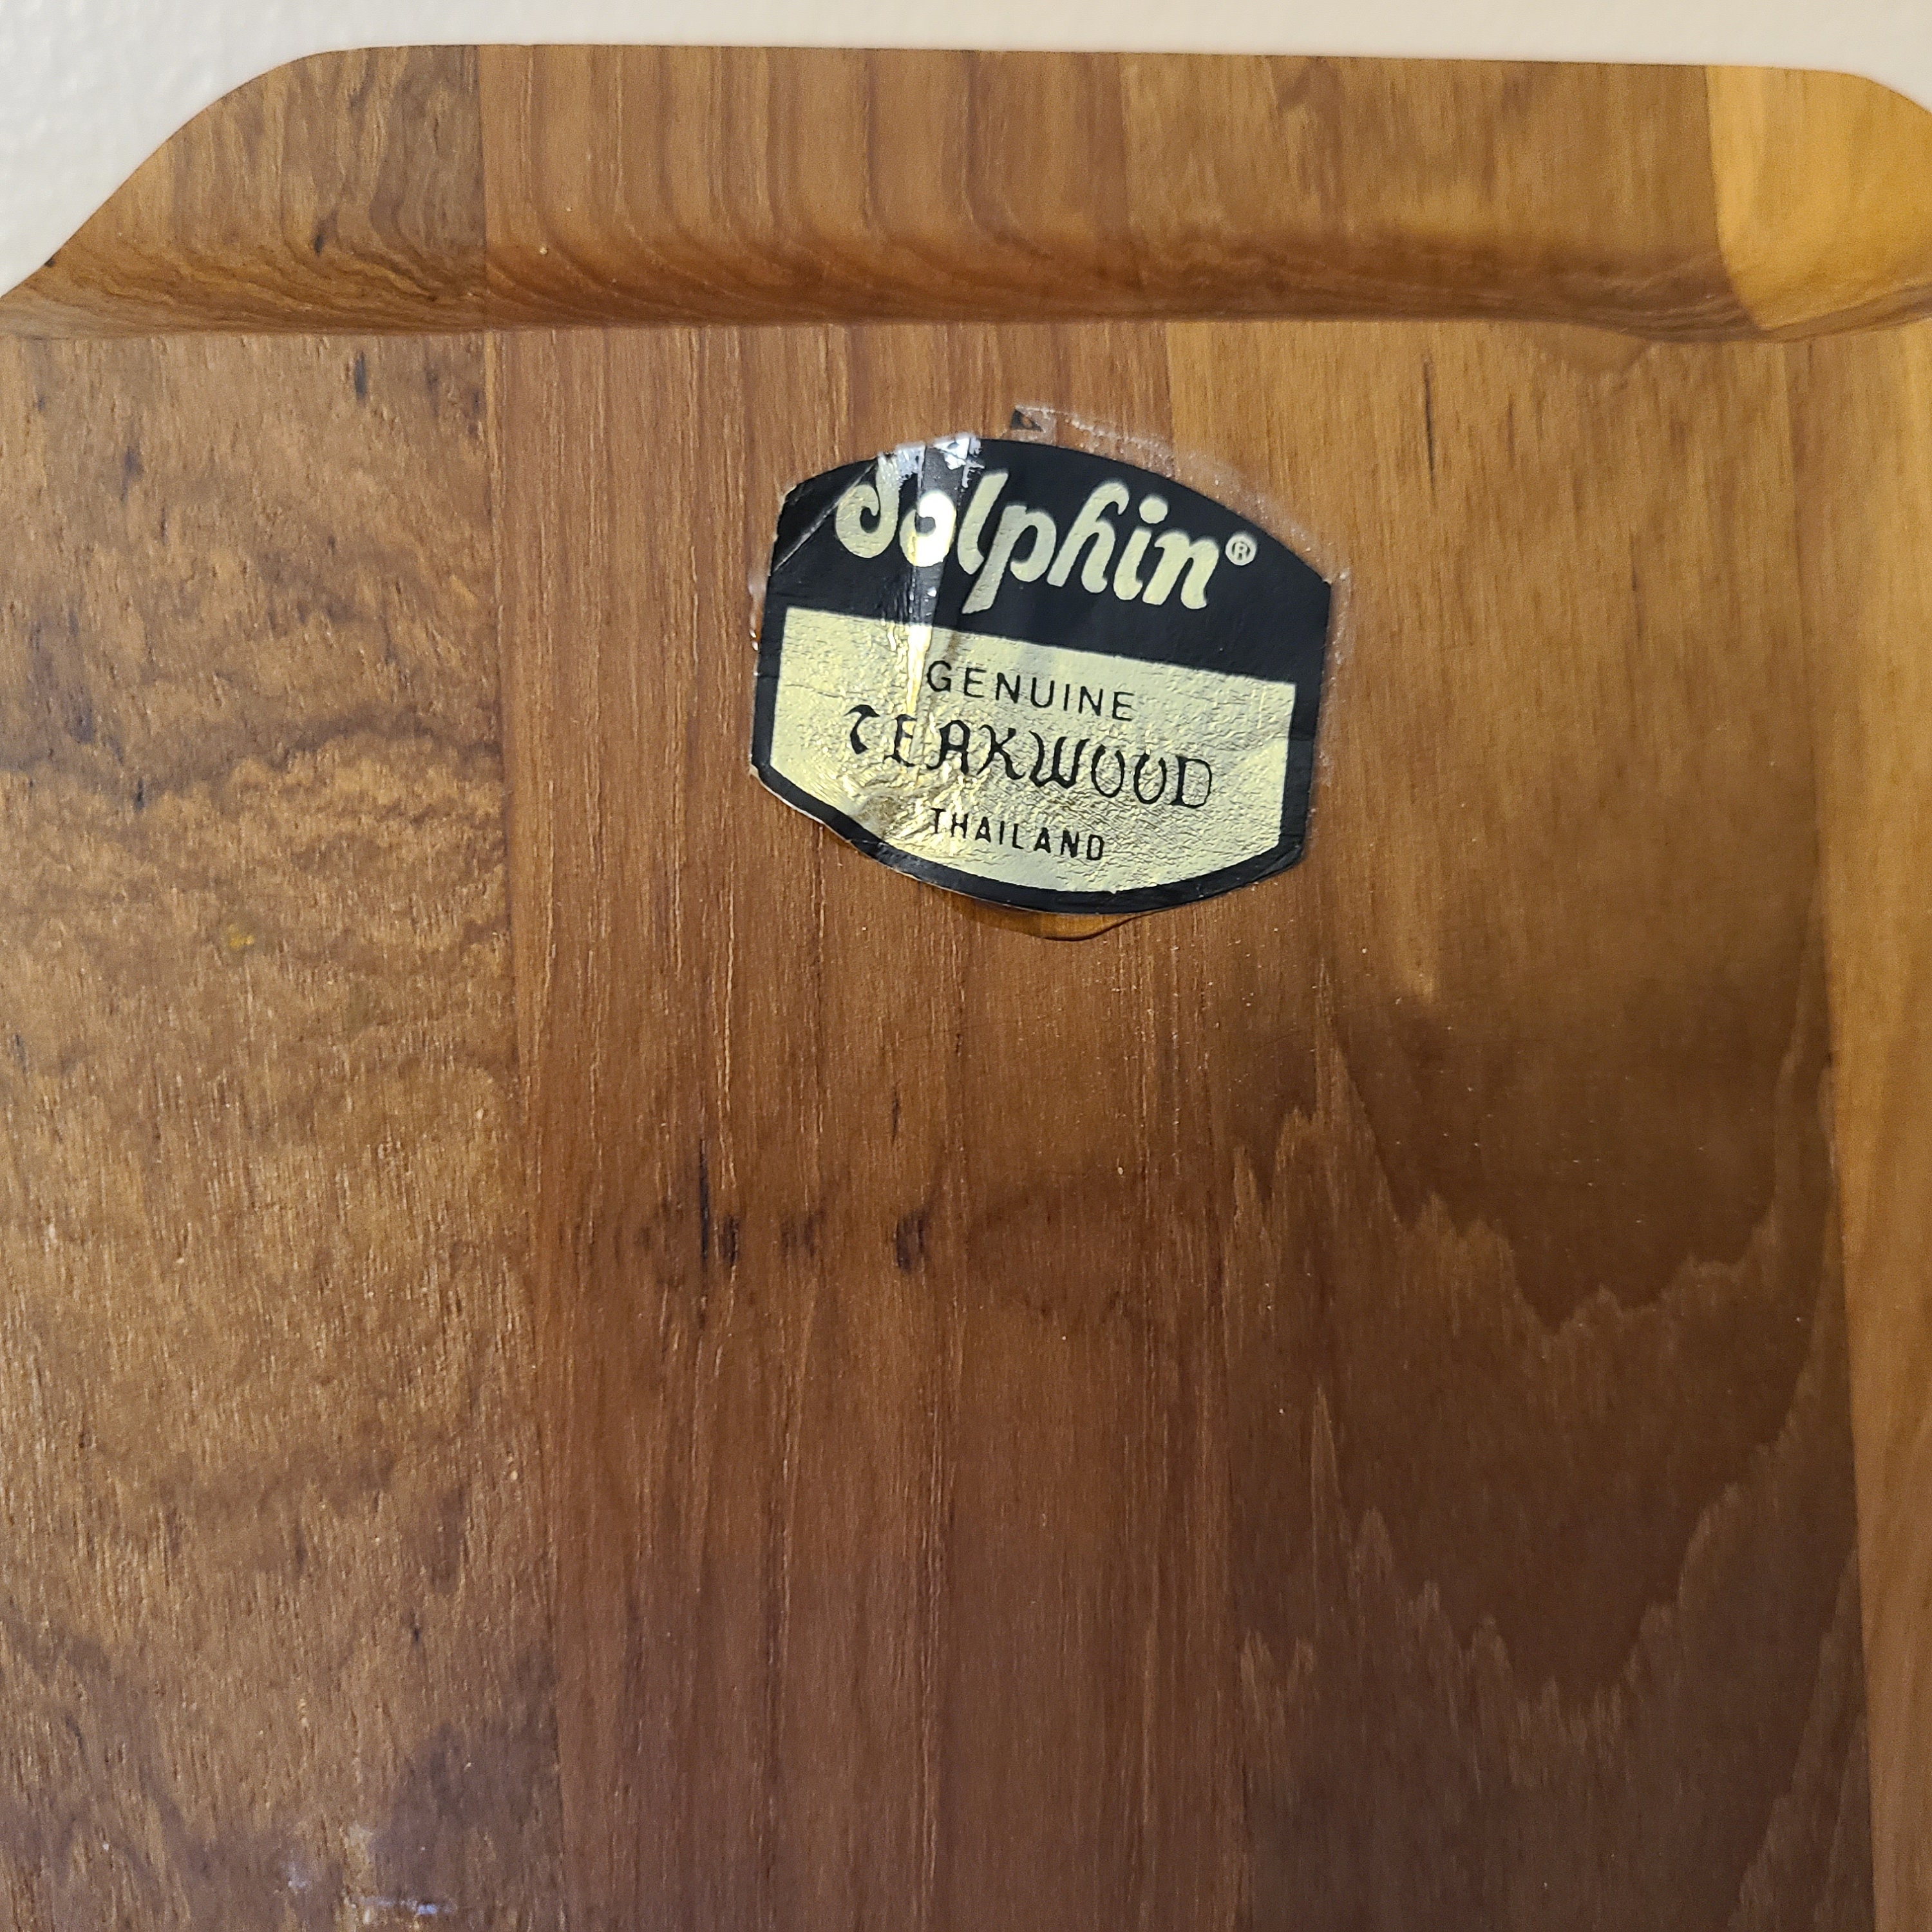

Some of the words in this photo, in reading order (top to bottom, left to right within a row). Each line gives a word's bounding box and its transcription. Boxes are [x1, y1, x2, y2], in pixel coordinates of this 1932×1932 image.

[925, 660, 1135, 722] GENUINE
[844, 704, 1213, 809] TEAKWOOD
[930, 808, 1104, 862] THAILAND
